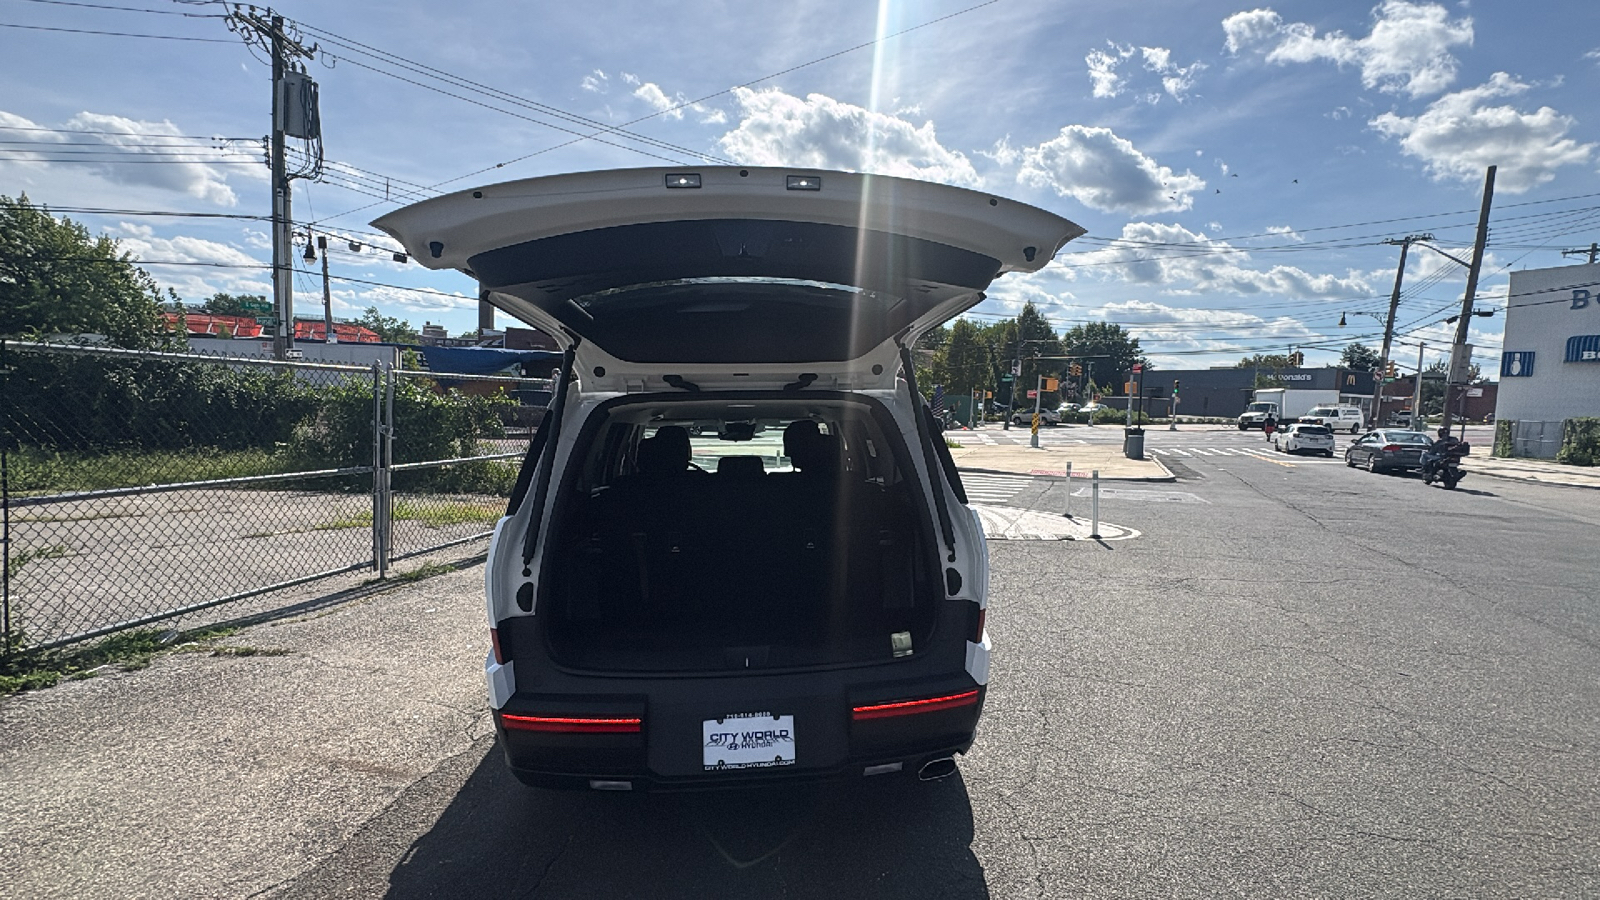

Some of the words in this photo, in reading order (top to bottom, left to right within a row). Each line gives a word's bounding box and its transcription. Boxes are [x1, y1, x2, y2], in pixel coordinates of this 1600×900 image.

[1570, 290, 1600, 310] B
[1582, 351, 1600, 360] B
[710, 733, 739, 742] CITY
[741, 730, 789, 740] WORLD
[741, 741, 773, 749] HYUNDAI
